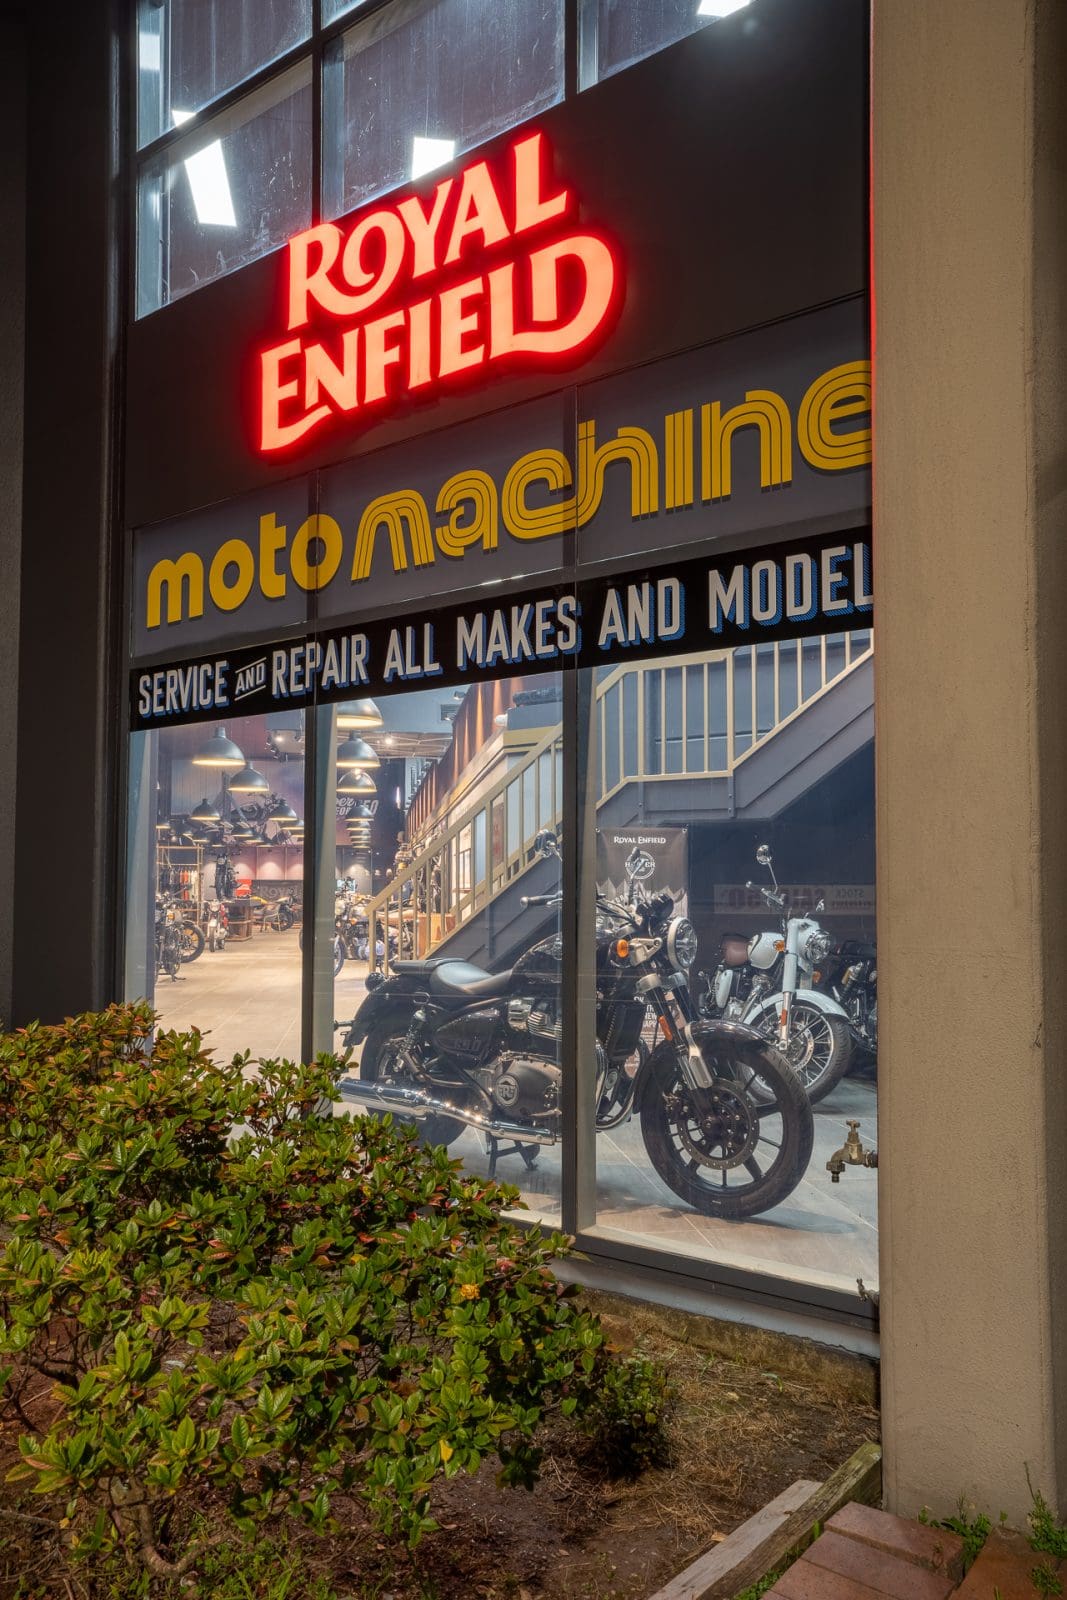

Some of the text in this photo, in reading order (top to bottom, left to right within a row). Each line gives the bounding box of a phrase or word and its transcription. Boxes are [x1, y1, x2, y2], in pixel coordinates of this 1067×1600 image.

[287, 133, 568, 331] ROYAL
[260, 236, 615, 452] ENFIELD
[147, 511, 343, 629] moto
[138, 660, 229, 717] SERVICE
[235, 661, 266, 697] AND
[271, 634, 369, 699] REPAIR
[384, 623, 443, 680] ALL
[456, 595, 582, 671] MAKES
[598, 577, 685, 648] AND
[613, 836, 667, 844] ROYAL ENFIELD
